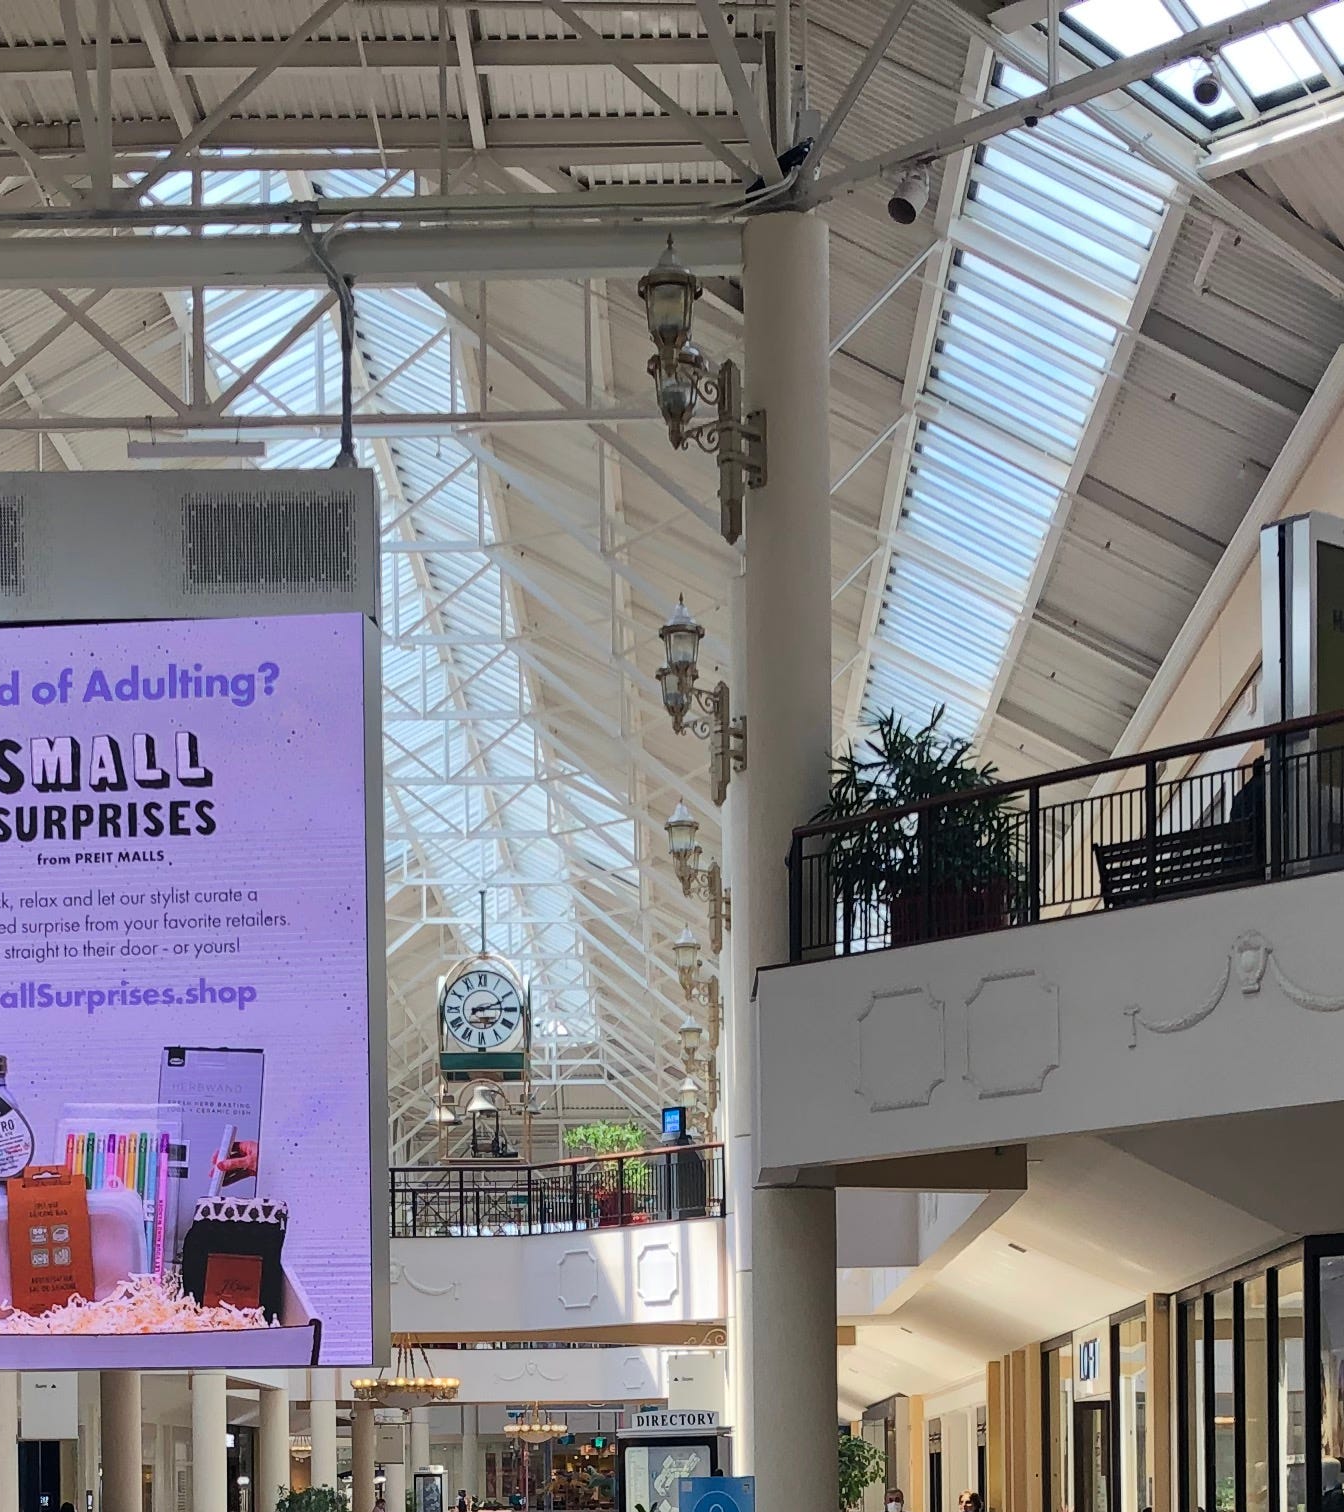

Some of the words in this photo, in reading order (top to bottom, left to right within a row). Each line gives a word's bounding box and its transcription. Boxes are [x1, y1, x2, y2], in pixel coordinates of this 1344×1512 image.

[31, 668, 73, 705] of
[82, 662, 281, 707] Adulting?
[37, 853, 71, 865] from
[75, 851, 113, 864] PREIT
[118, 850, 164, 863] MALLS
[20, 891, 58, 908] relax
[63, 889, 93, 907] and
[98, 889, 115, 906] let
[120, 893, 145, 905] our
[150, 887, 190, 908] stylist
[194, 889, 242, 903] curate
[247, 890, 258, 901] a
[21, 918, 80, 938] surprise
[85, 914, 119, 932] from
[124, 919, 158, 935] your
[163, 912, 221, 930] favorite
[226, 910, 291, 928] retailers.
[5, 941, 59, 963] straight
[64, 944, 78, 957] to
[83, 940, 115, 957] their
[120, 939, 158, 956] door
[173, 943, 191, 954] or
[194, 937, 240, 959] yours!
[217, 1101, 251, 1109] BASTING
[636, 1413, 716, 1427] DIRECTORY
